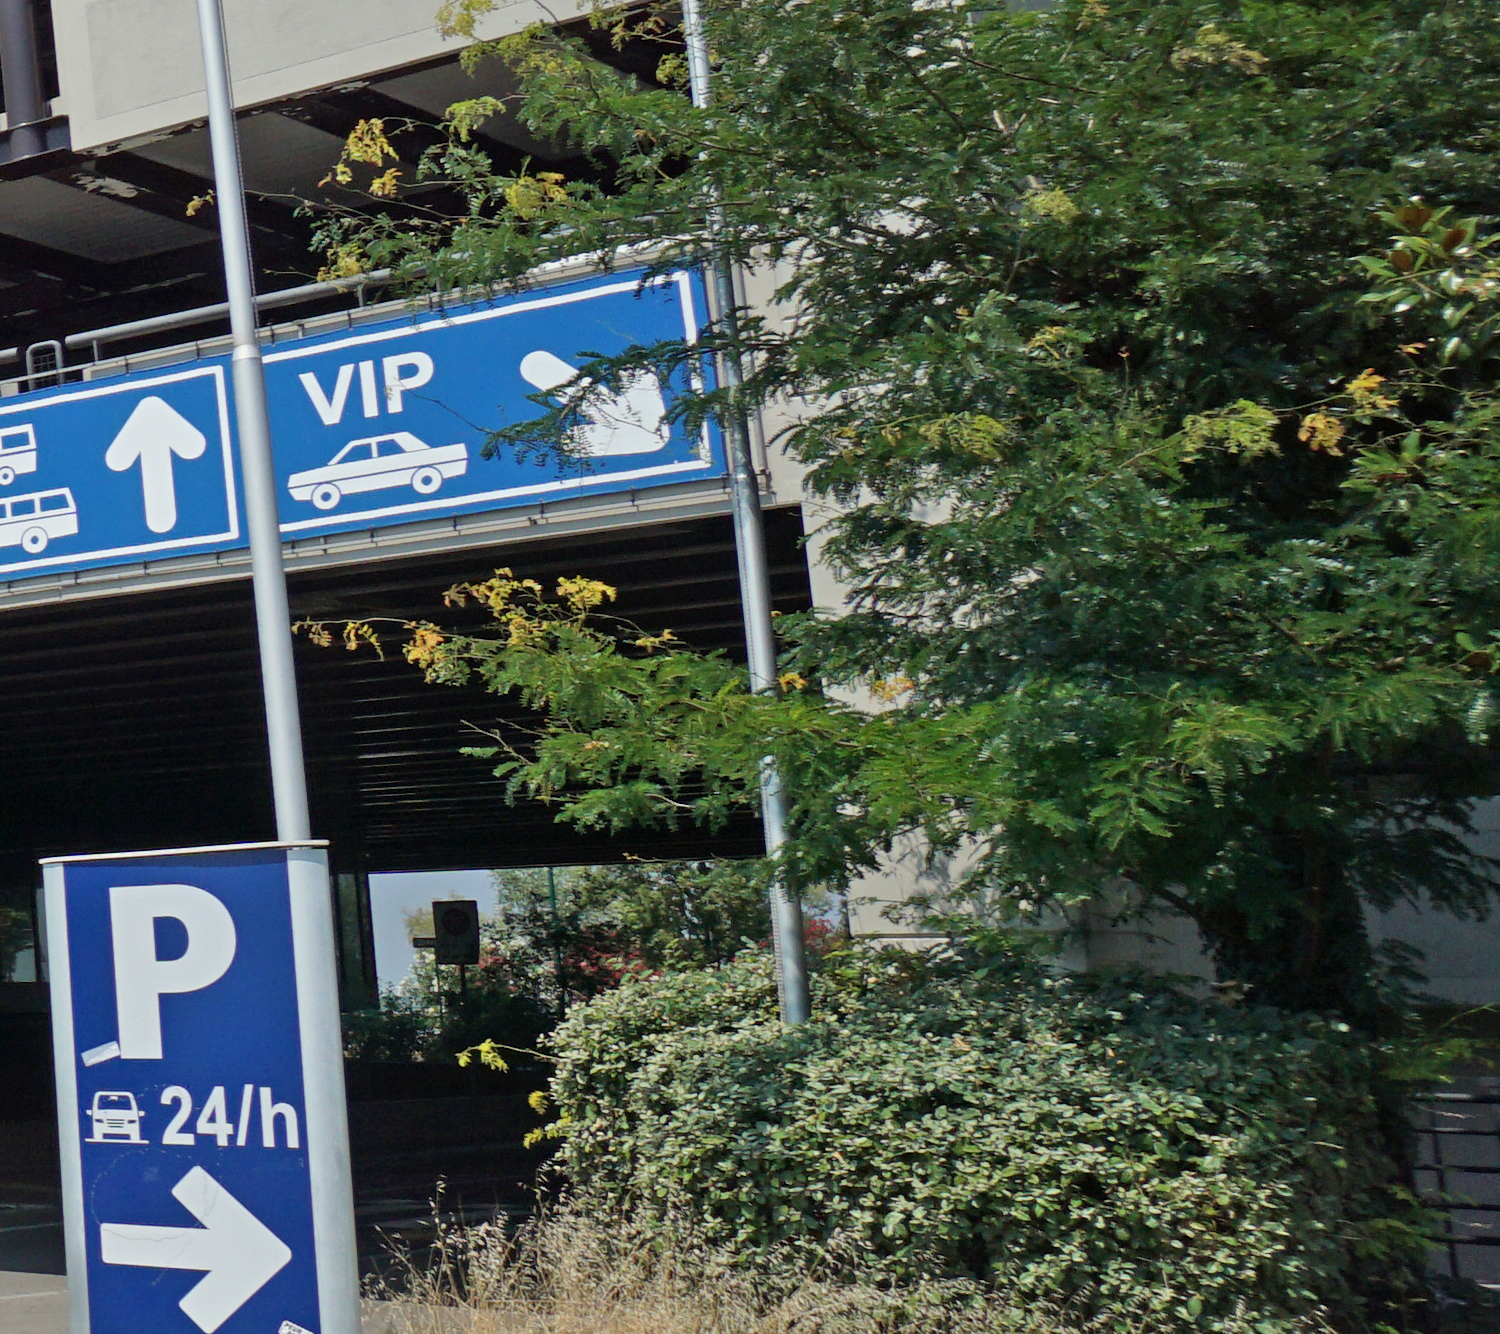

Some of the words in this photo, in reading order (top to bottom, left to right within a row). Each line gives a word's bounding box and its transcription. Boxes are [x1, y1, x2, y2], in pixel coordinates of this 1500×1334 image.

[298, 351, 434, 426] VIP
[109, 883, 237, 1059] P
[160, 1083, 299, 1149] 24/h
